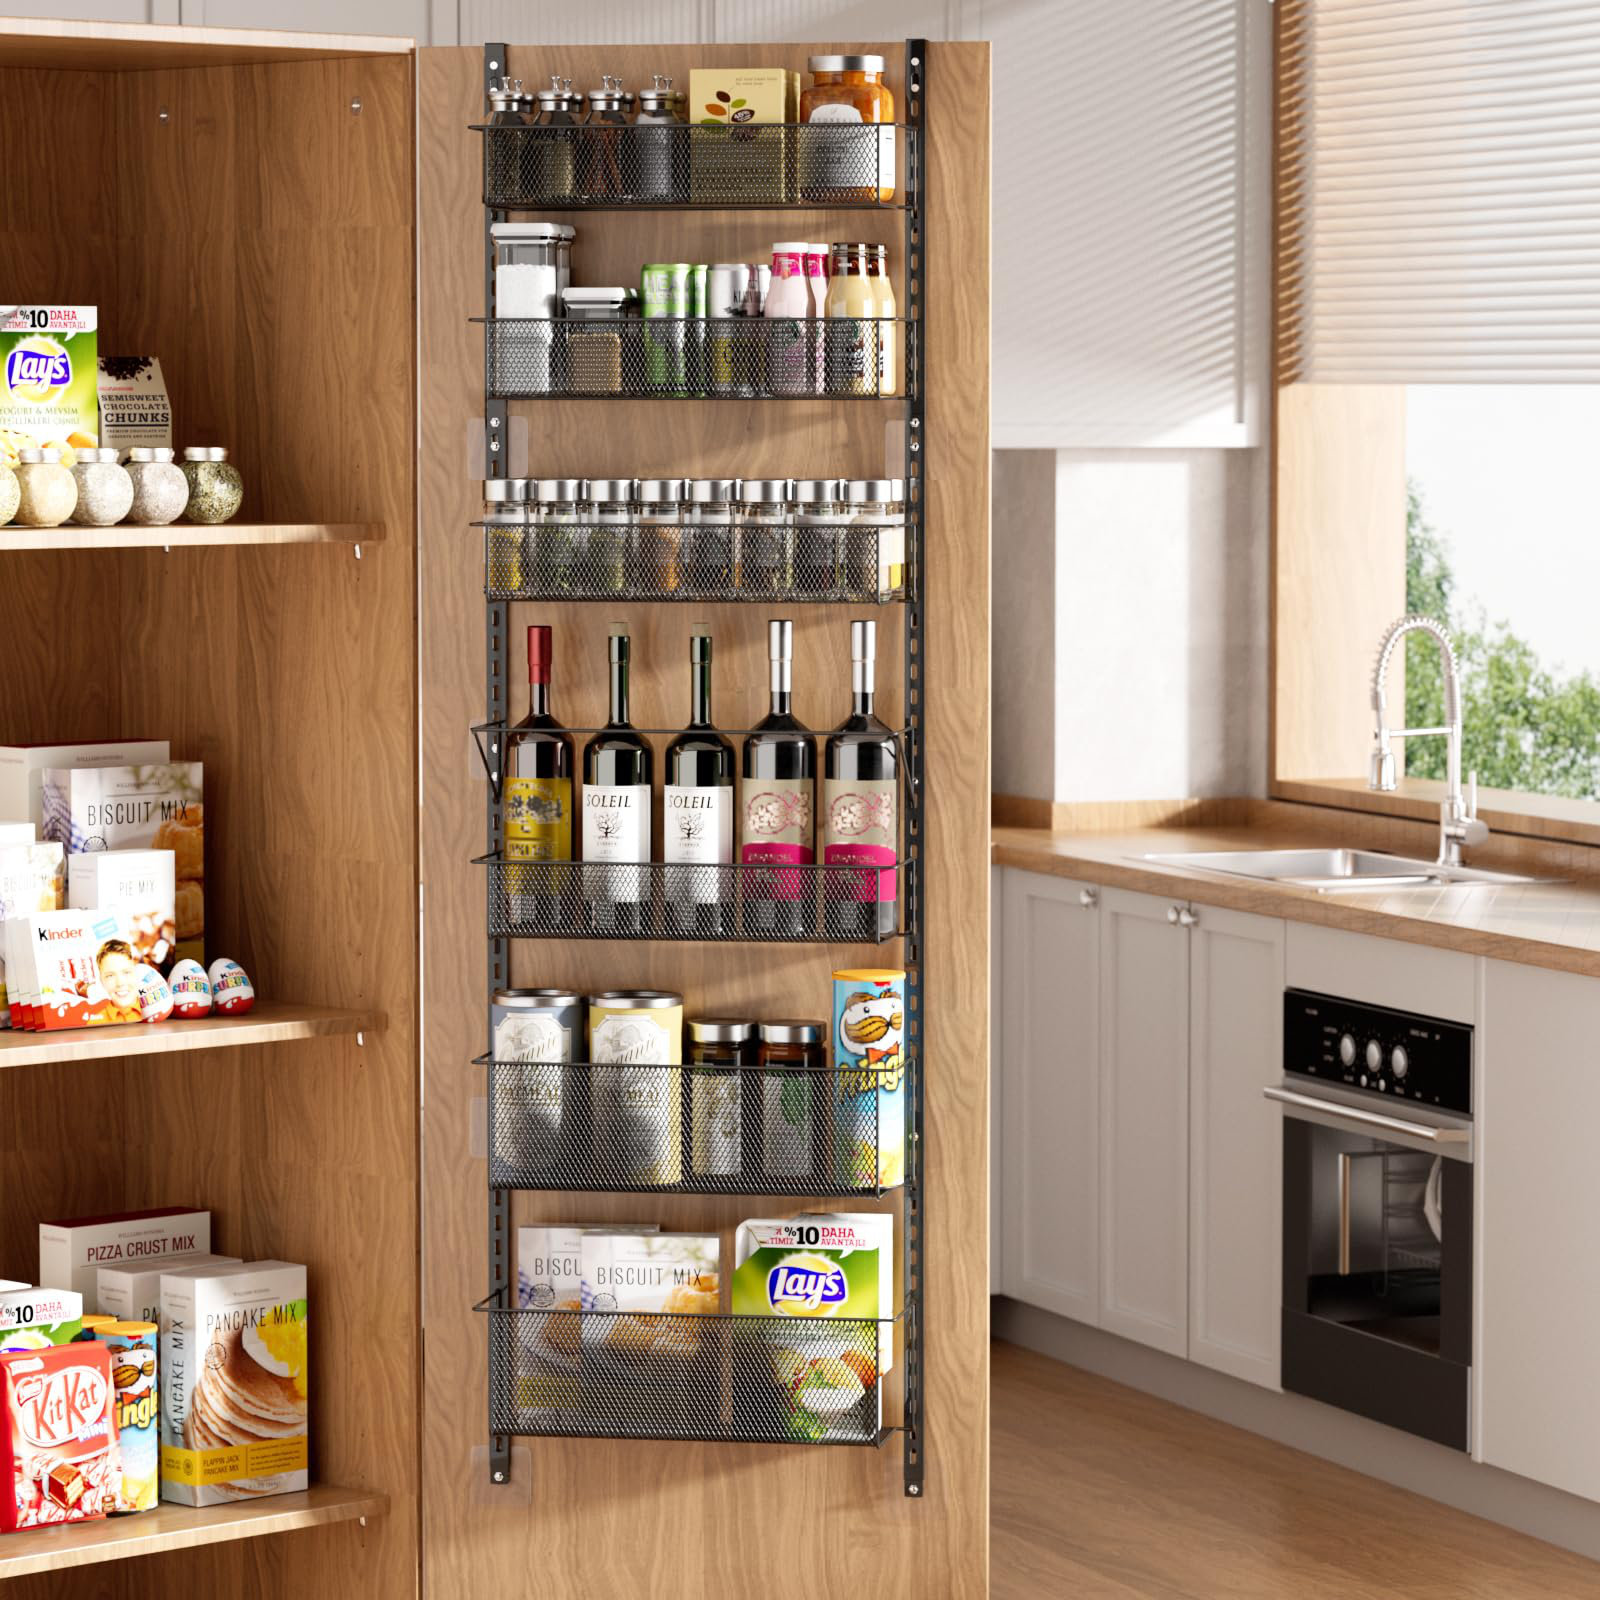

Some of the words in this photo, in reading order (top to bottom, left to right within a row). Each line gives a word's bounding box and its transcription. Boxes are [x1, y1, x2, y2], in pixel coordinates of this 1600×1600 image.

[50, 310, 77, 320] DAHA
[101, 394, 165, 402] SEMISWEET
[103, 403, 169, 411] CHOCOLATE
[104, 412, 170, 423] CHUNKS
[586, 794, 632, 808] SOLEIL
[669, 795, 713, 809] SOLEIL
[88, 801, 151, 826] BISCUIT
[161, 799, 188, 822] MIX
[119, 881, 133, 896] PIE
[138, 880, 156, 893] MIX
[821, 1227, 855, 1238] DAHA
[87, 1244, 123, 1262] PIZZA
[127, 1238, 168, 1257] CRUST
[172, 1234, 196, 1251] MIX
[821, 1238, 866, 1247] AVANTAJLI
[597, 1266, 664, 1286] BISCUIT
[673, 1268, 702, 1286] MIX
[35, 1301, 62, 1314] DAHA
[206, 1307, 267, 1333] PANCAKE
[273, 1303, 297, 1325] MIX
[172, 1319, 184, 1350] MIX
[172, 1359, 184, 1437] PANCAKE
